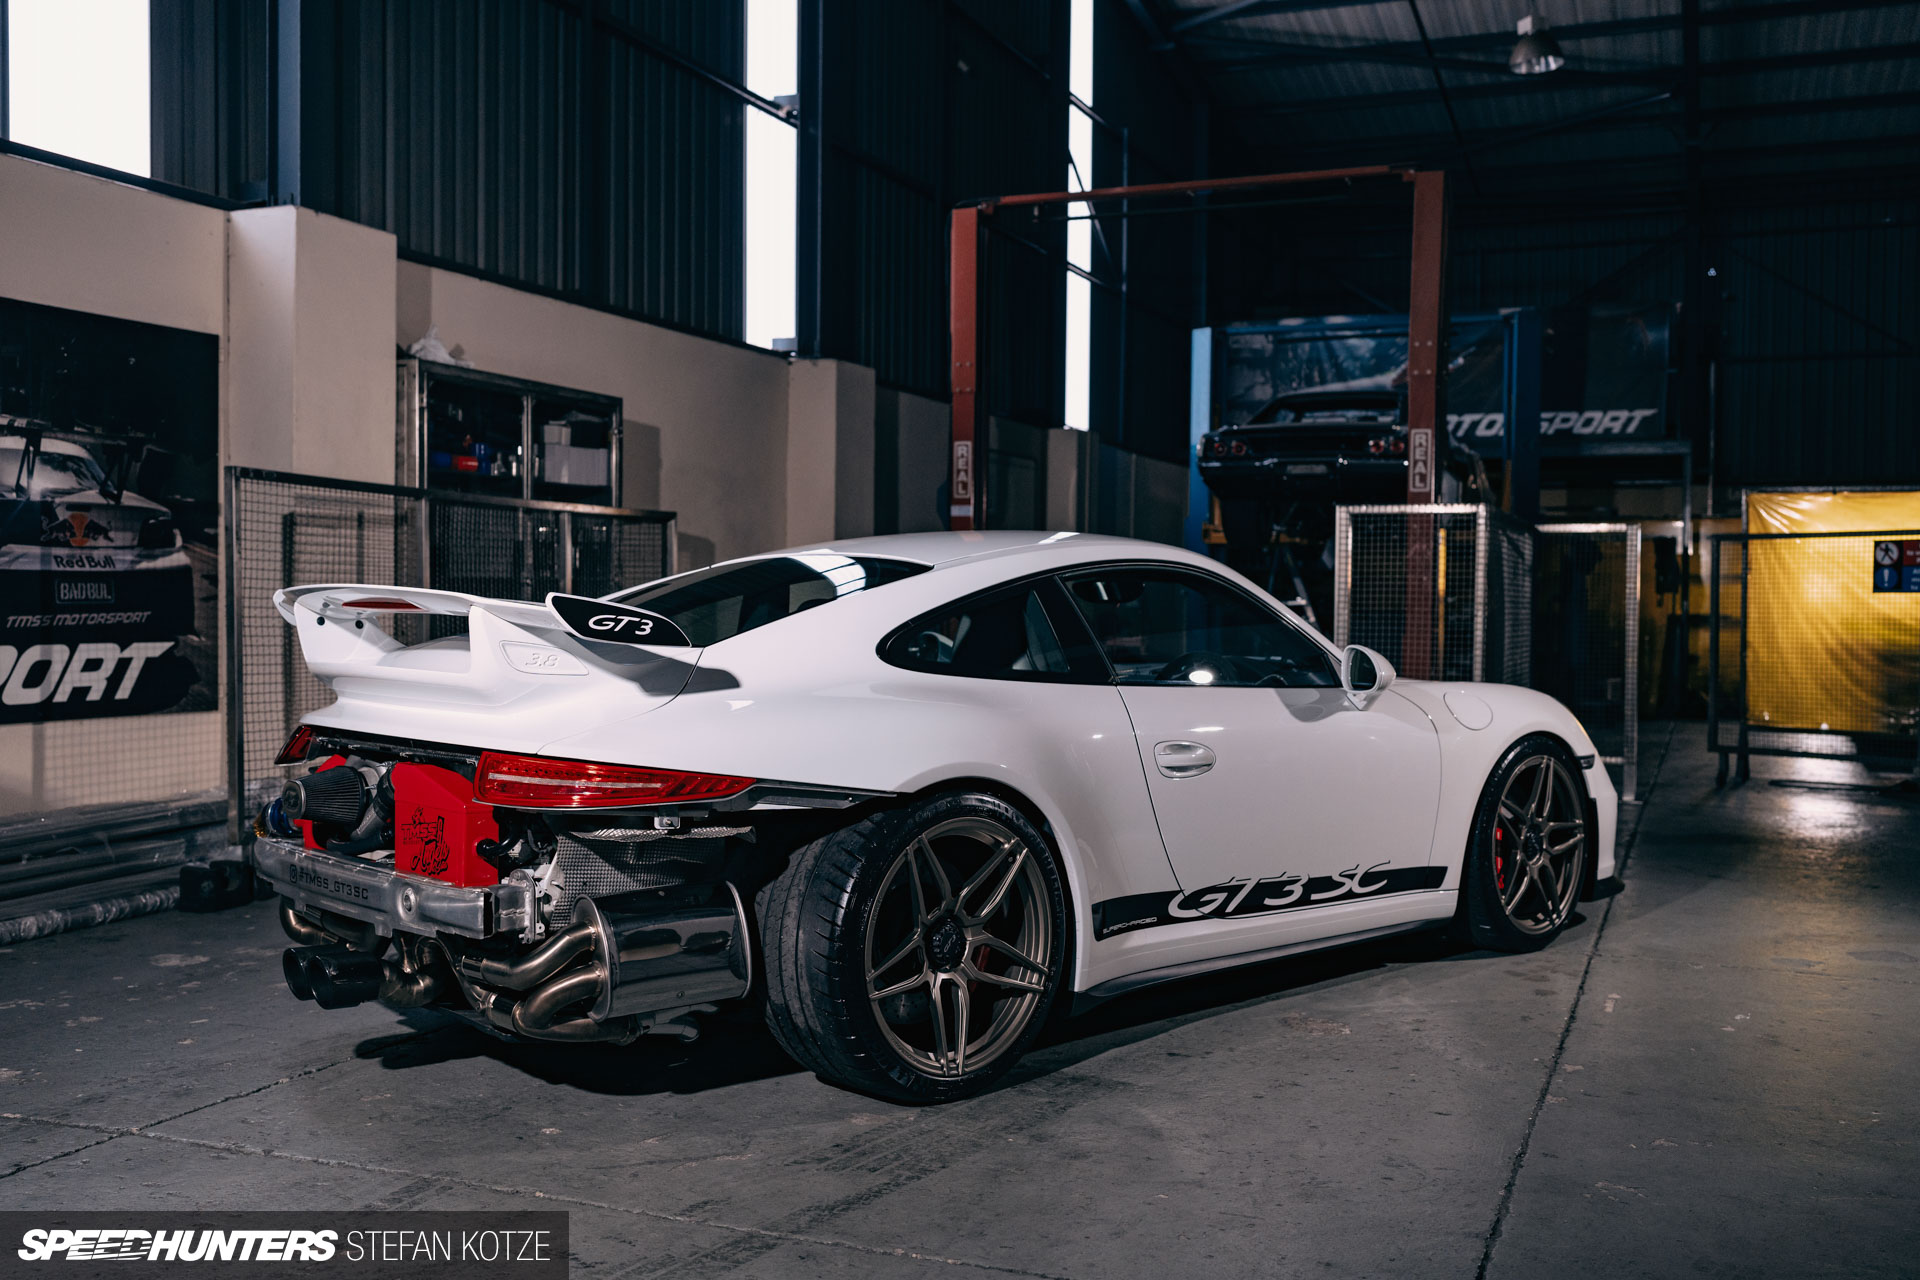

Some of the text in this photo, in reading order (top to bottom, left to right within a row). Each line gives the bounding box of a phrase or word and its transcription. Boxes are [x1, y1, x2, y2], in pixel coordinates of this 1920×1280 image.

[957, 445, 968, 495] REAL
[1414, 433, 1428, 488] REAL
[53, 555, 116, 569] Red Bull
[6, 611, 152, 629] TMSS MOTORSPORT
[588, 614, 654, 636] GT3
[525, 652, 560, 668] 3.8
[1311, 860, 1391, 900] SC
